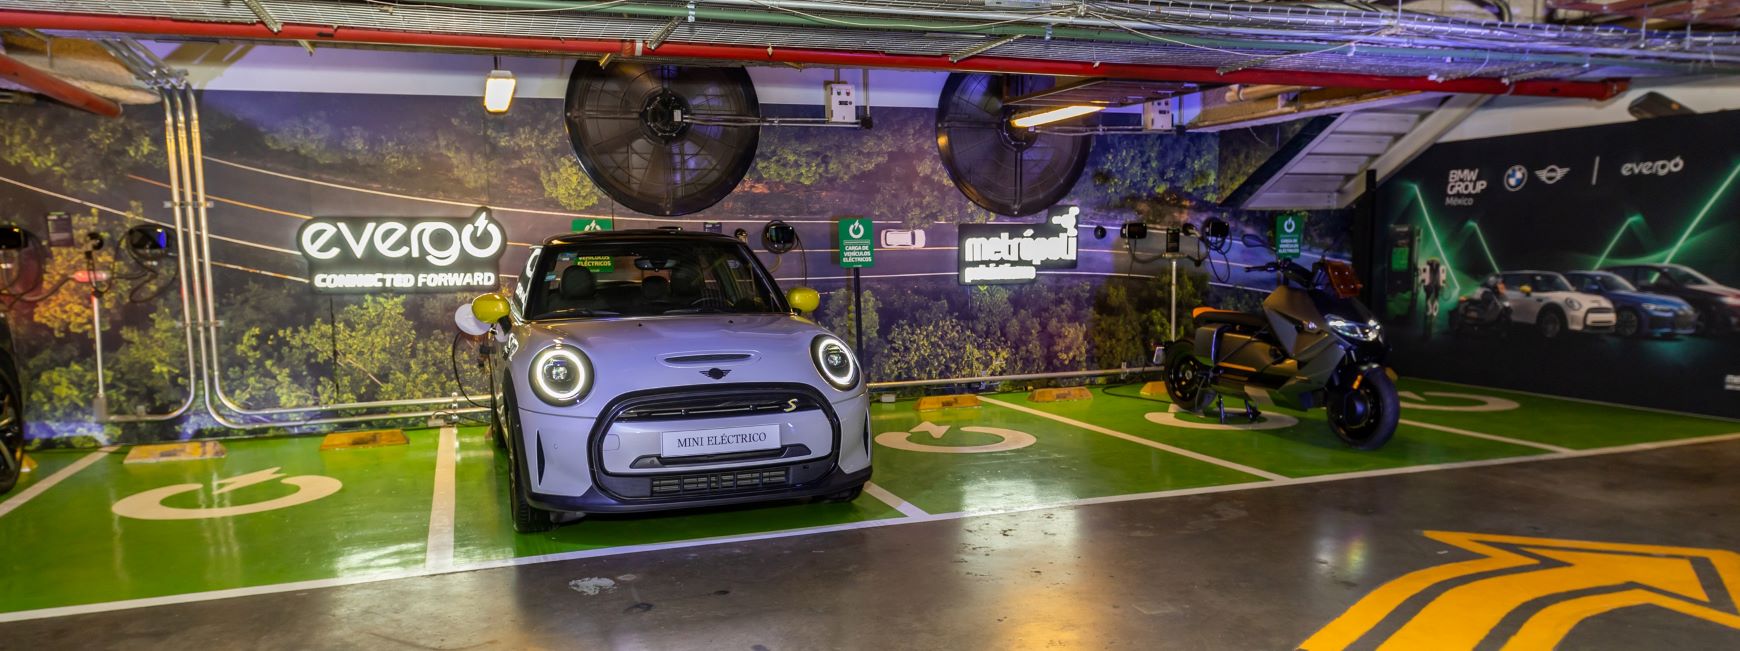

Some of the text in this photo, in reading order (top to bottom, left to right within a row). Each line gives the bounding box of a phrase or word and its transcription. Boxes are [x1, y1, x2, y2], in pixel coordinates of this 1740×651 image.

[1449, 168, 1479, 182] BMW
[1447, 180, 1487, 195] GROUP
[301, 211, 501, 266] evergo
[314, 271, 496, 289] CONNECTED FORWARD
[677, 431, 767, 448] MINI ELÉCTRICO
